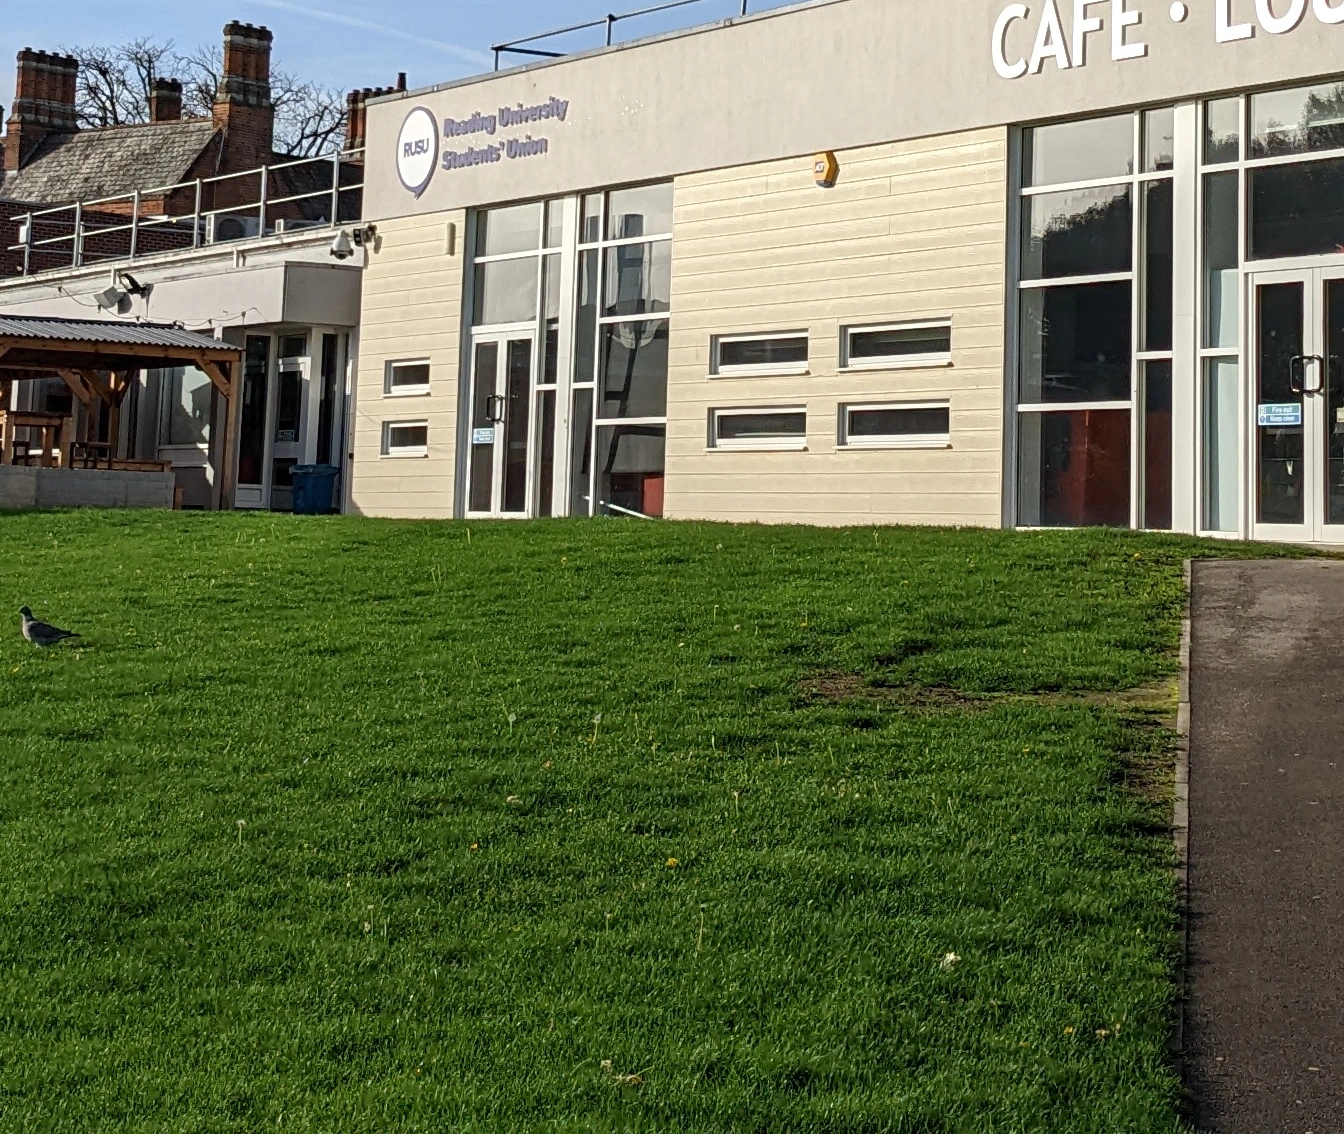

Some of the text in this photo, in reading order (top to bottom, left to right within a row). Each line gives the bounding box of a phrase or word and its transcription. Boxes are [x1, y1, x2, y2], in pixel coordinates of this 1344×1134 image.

[444, 96, 569, 138] Reading University
[403, 138, 429, 158] RUSU
[506, 134, 548, 159] Union
